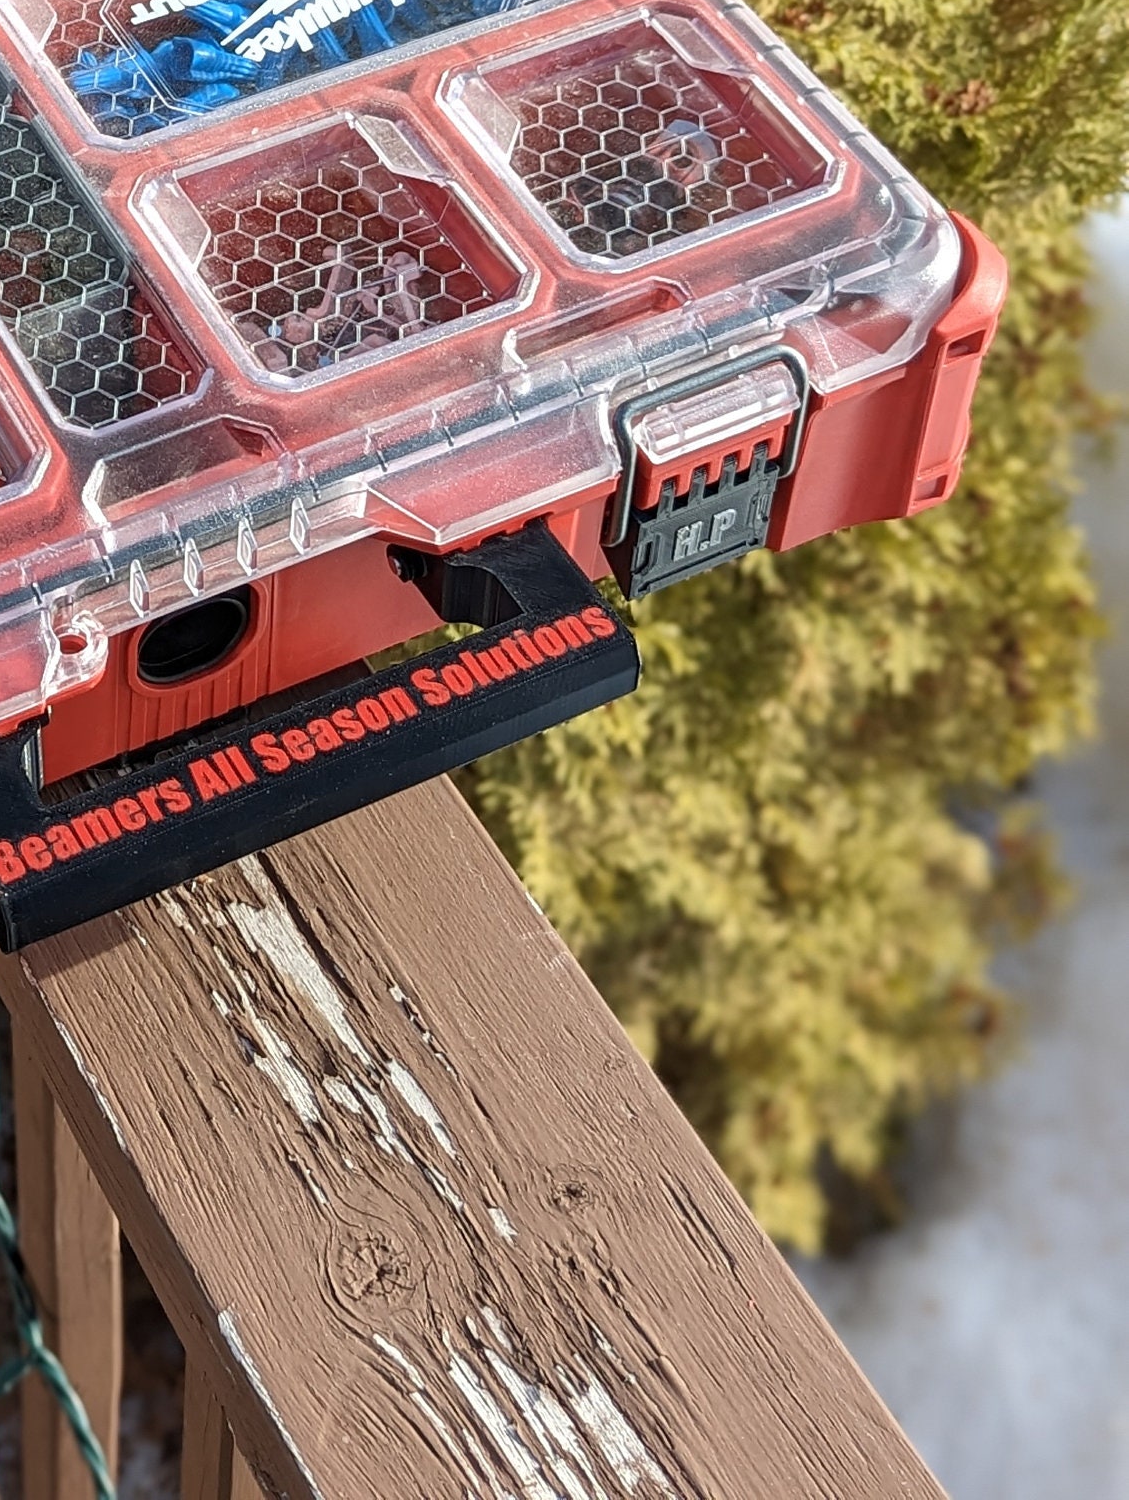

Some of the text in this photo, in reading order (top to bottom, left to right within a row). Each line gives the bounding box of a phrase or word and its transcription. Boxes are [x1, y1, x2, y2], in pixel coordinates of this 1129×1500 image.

[673, 509, 737, 561] H.P
[188, 745, 257, 802] All
[251, 686, 418, 773] Season
[410, 606, 616, 706] Solutions
